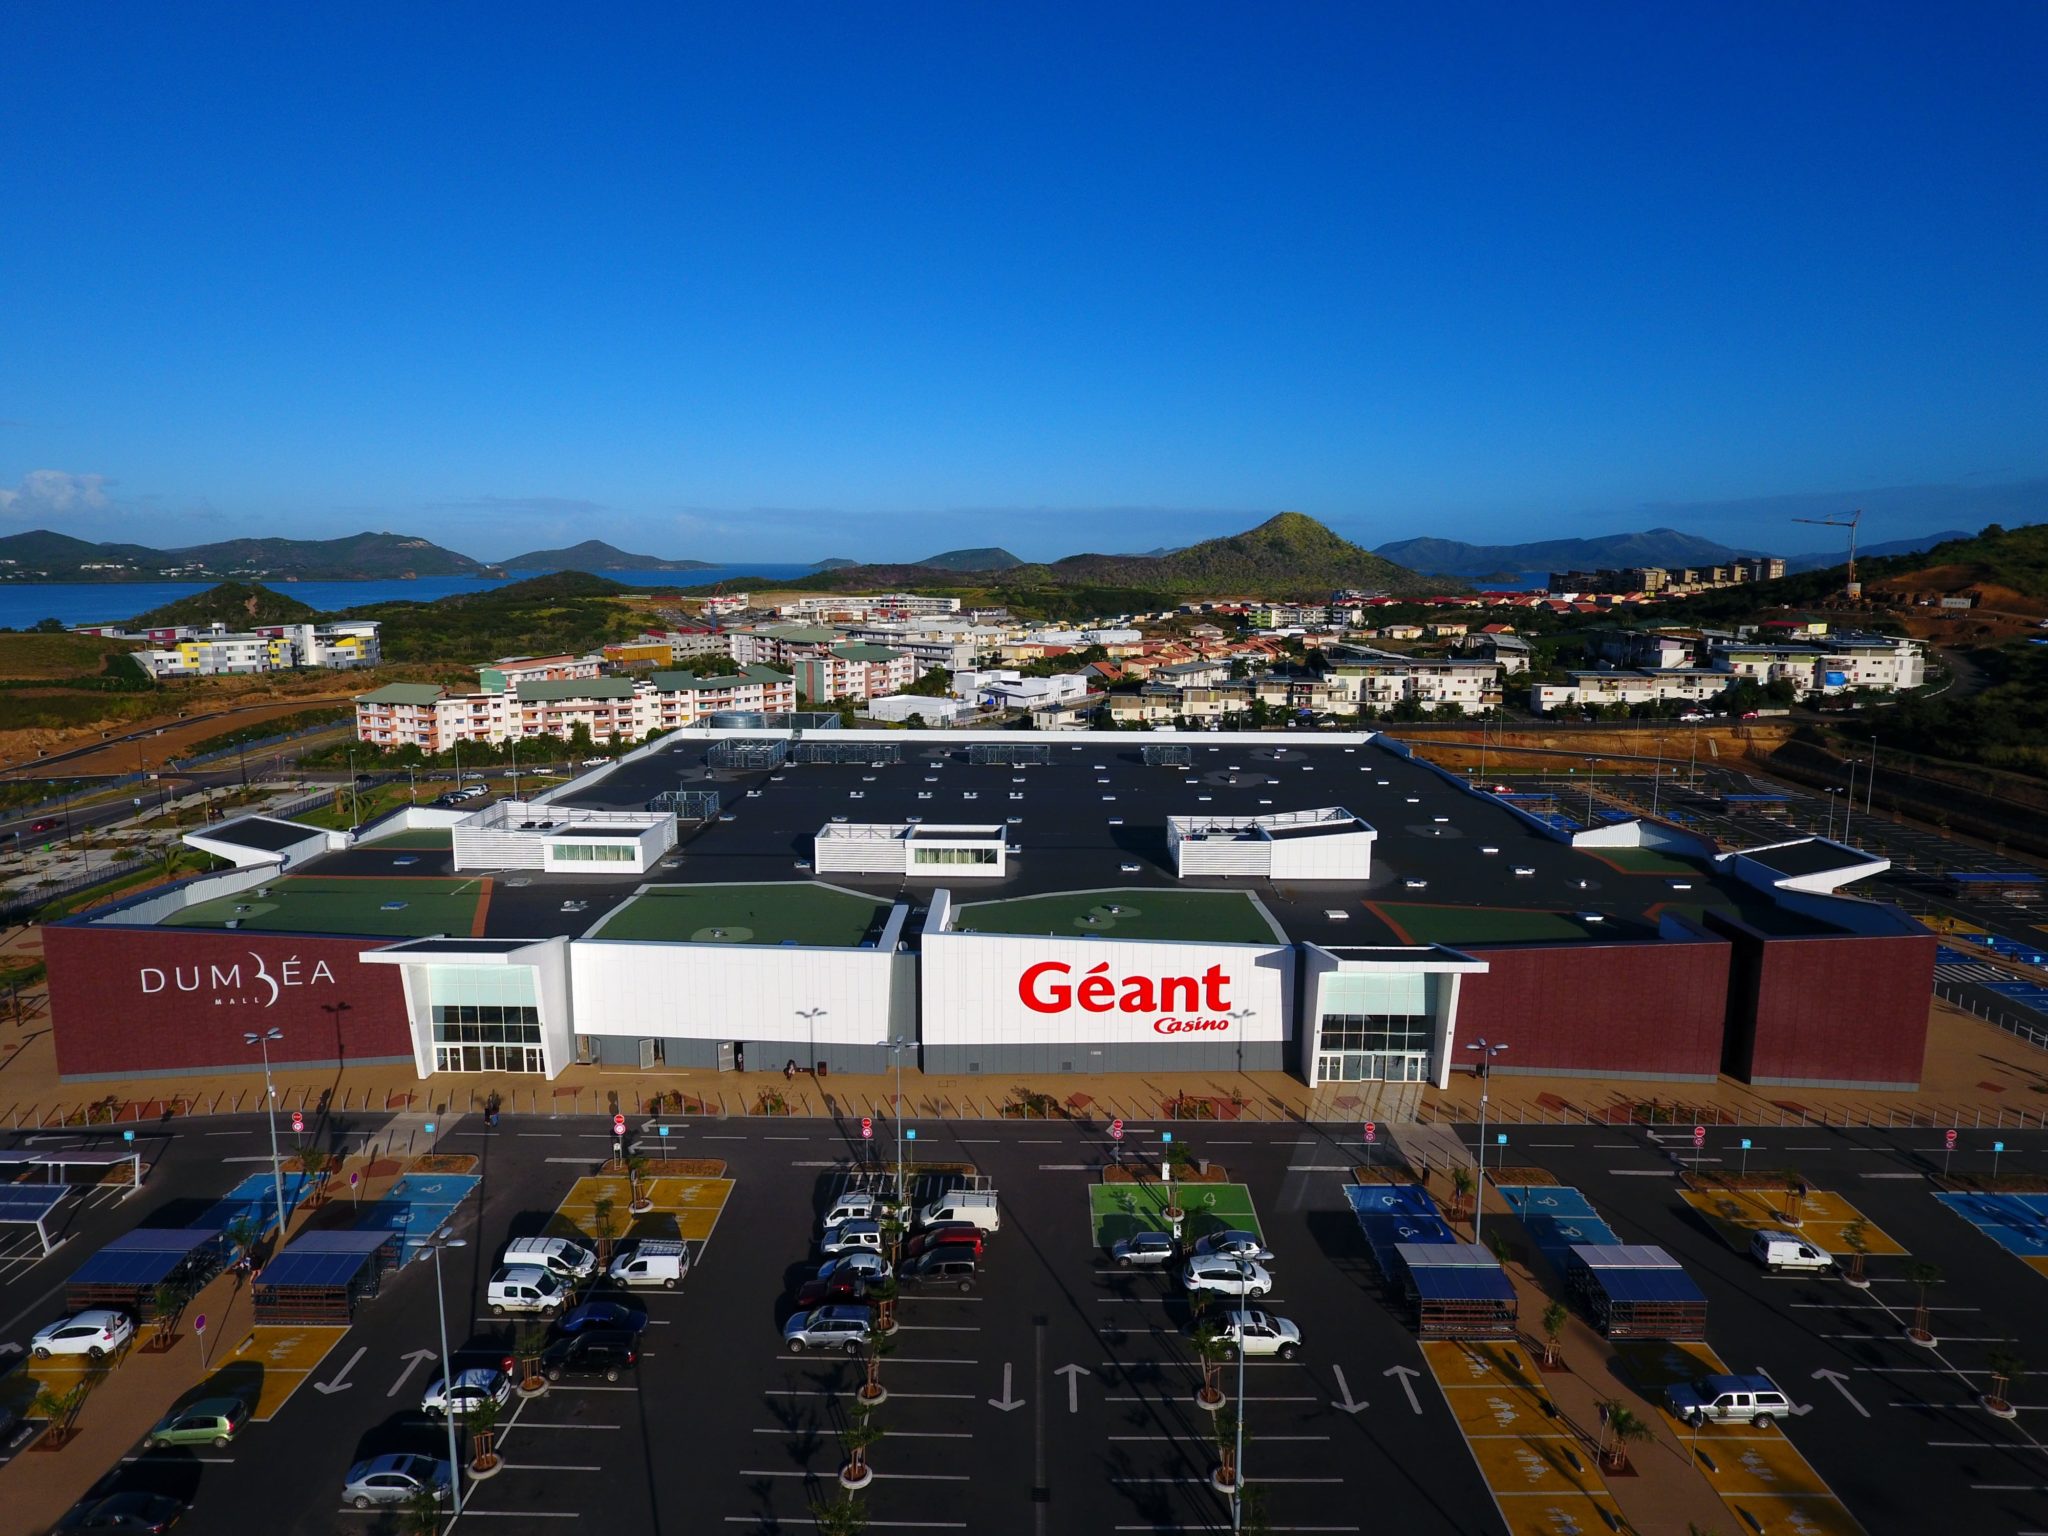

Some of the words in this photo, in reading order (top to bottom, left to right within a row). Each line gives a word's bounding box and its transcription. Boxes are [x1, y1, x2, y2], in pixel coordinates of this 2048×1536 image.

[1018, 961, 1232, 1014] Géant
[214, 996, 260, 1006] MALL
[1153, 1017, 1229, 1035] Casino
